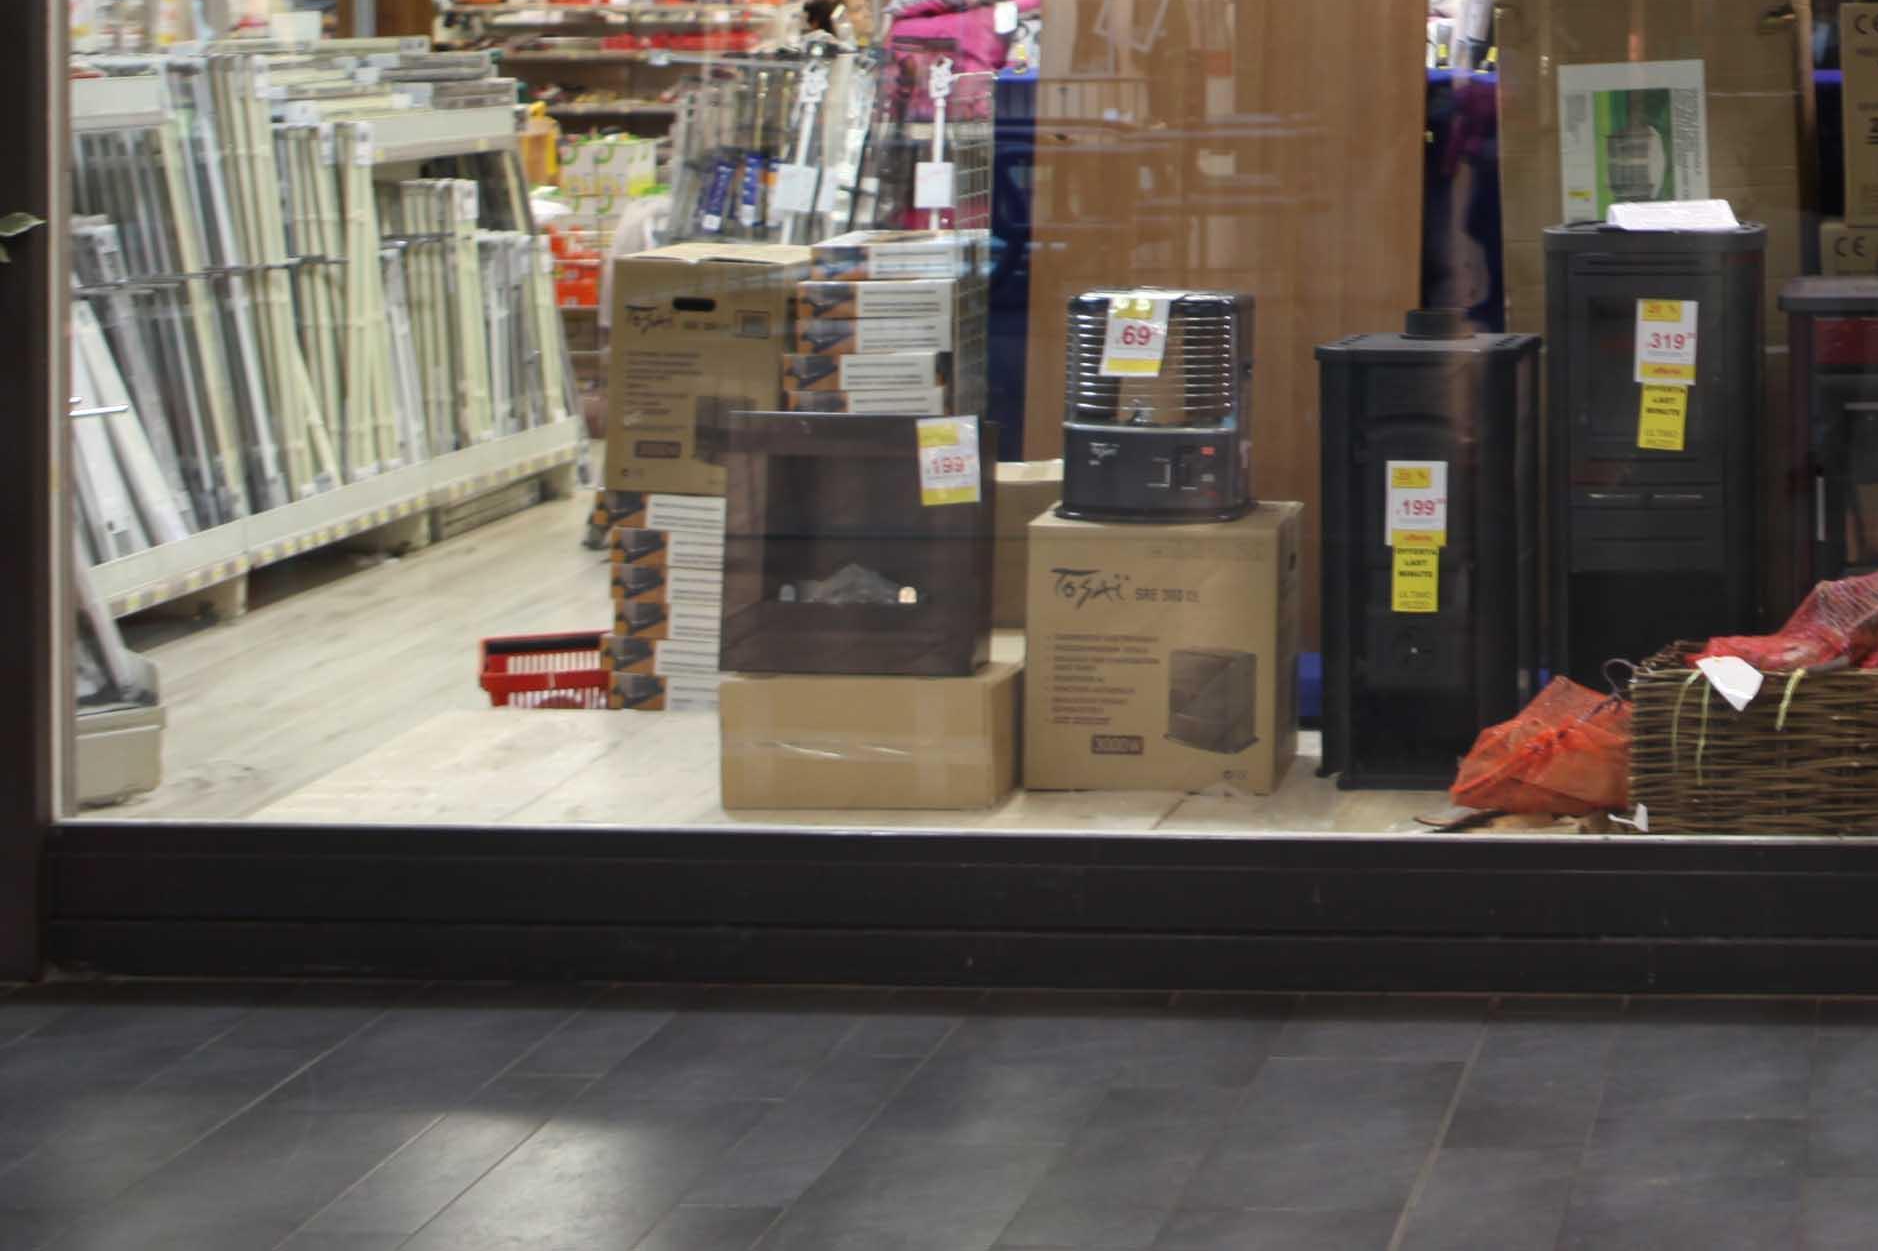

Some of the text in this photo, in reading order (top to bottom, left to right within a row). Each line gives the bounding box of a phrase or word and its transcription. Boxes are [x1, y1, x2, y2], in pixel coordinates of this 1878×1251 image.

[1122, 325, 1151, 346] 69
[1650, 332, 1686, 349] 319
[1402, 499, 1436, 517] 199
